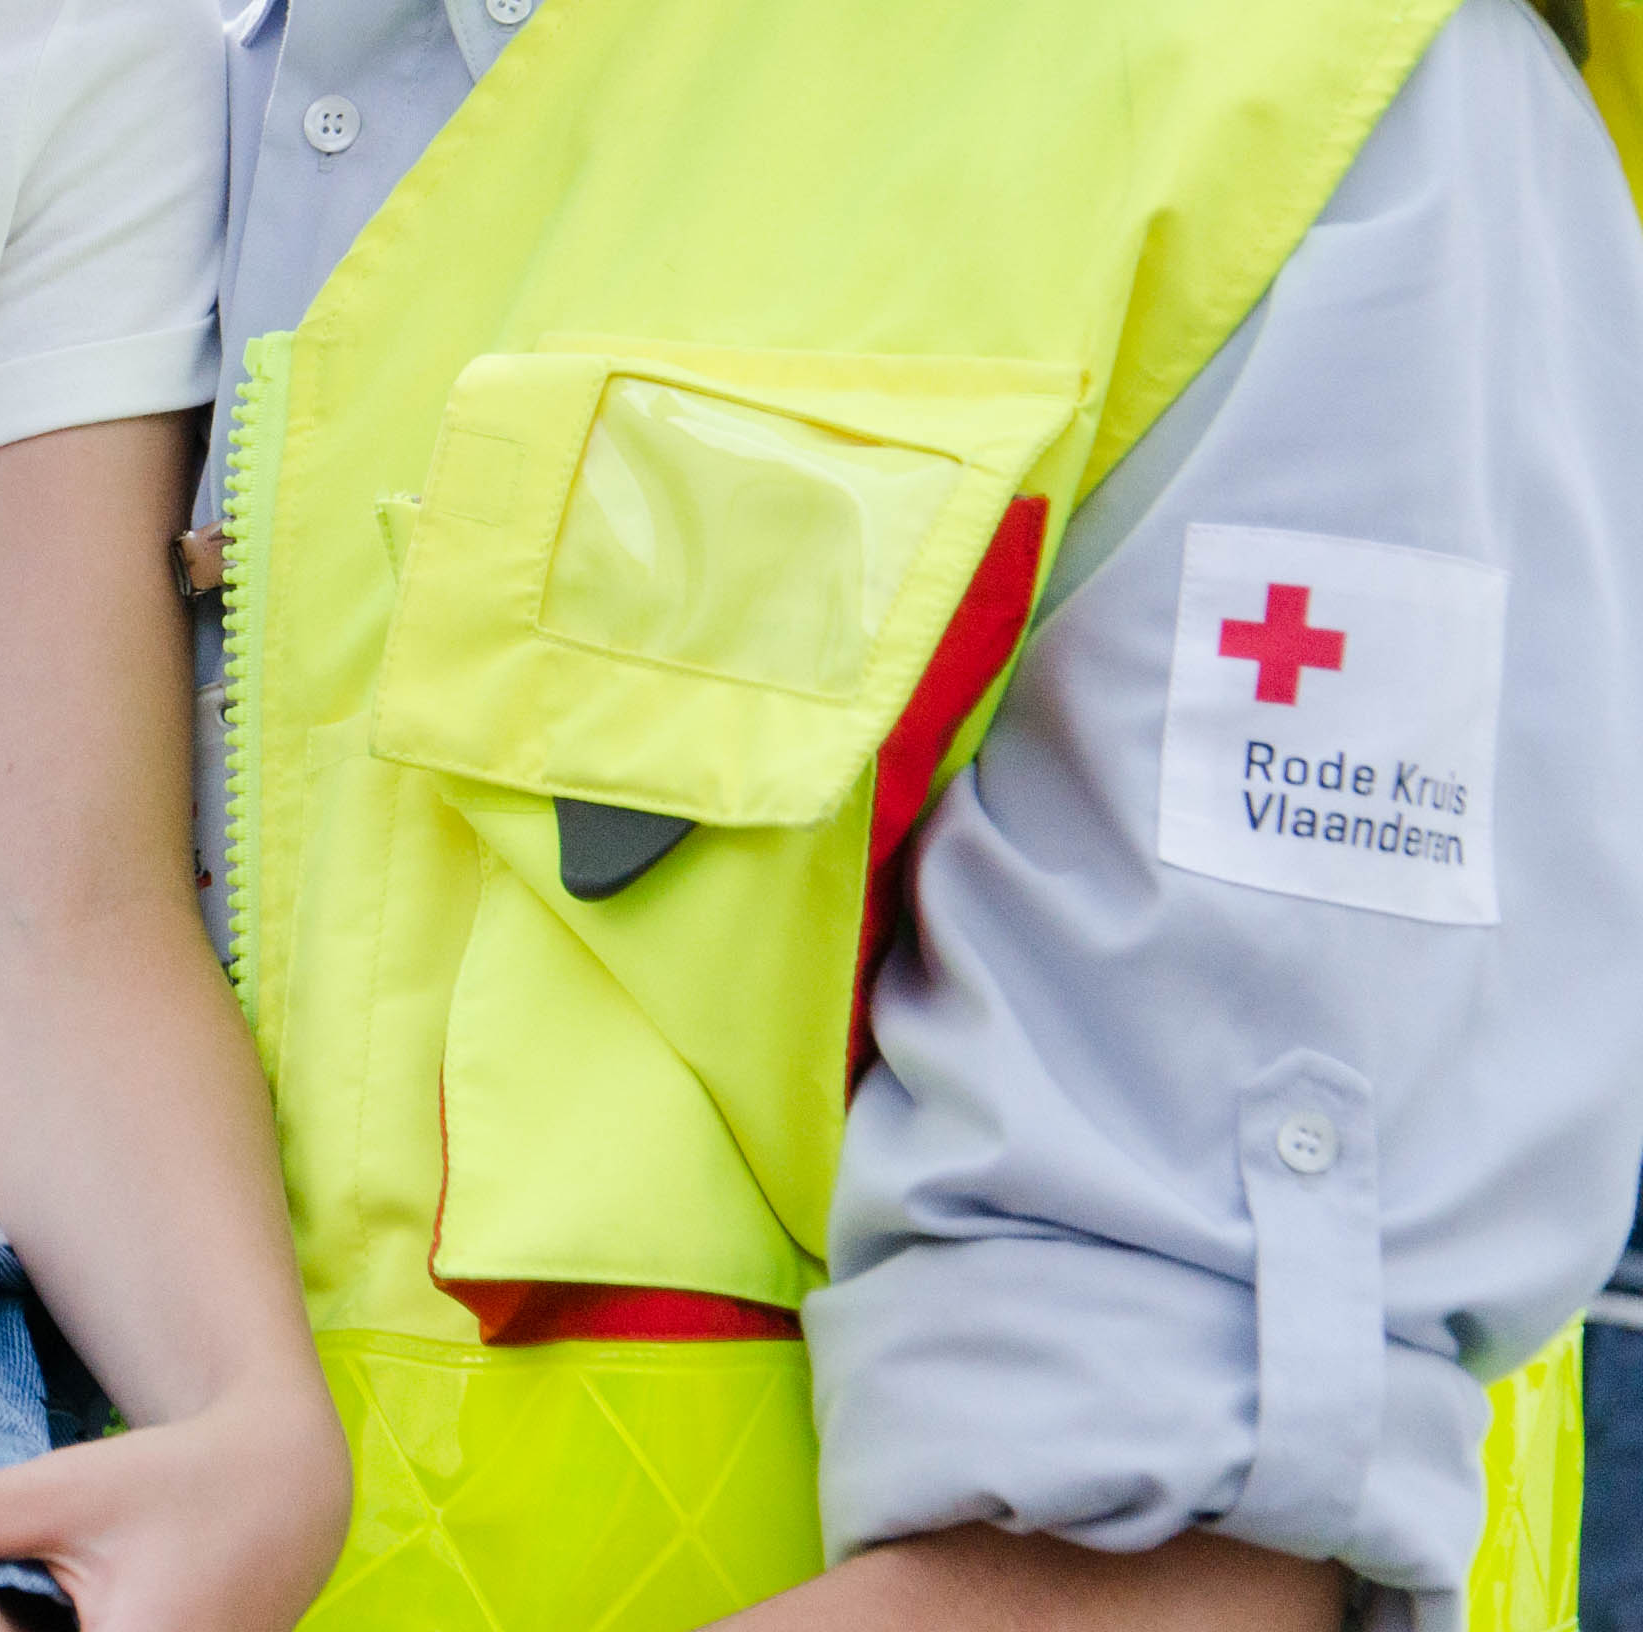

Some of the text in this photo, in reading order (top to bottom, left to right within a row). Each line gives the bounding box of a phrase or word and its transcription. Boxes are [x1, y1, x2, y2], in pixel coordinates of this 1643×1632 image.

[1243, 739, 1468, 817] Rode Kruis
[1242, 789, 1466, 866] Vlaanderen
